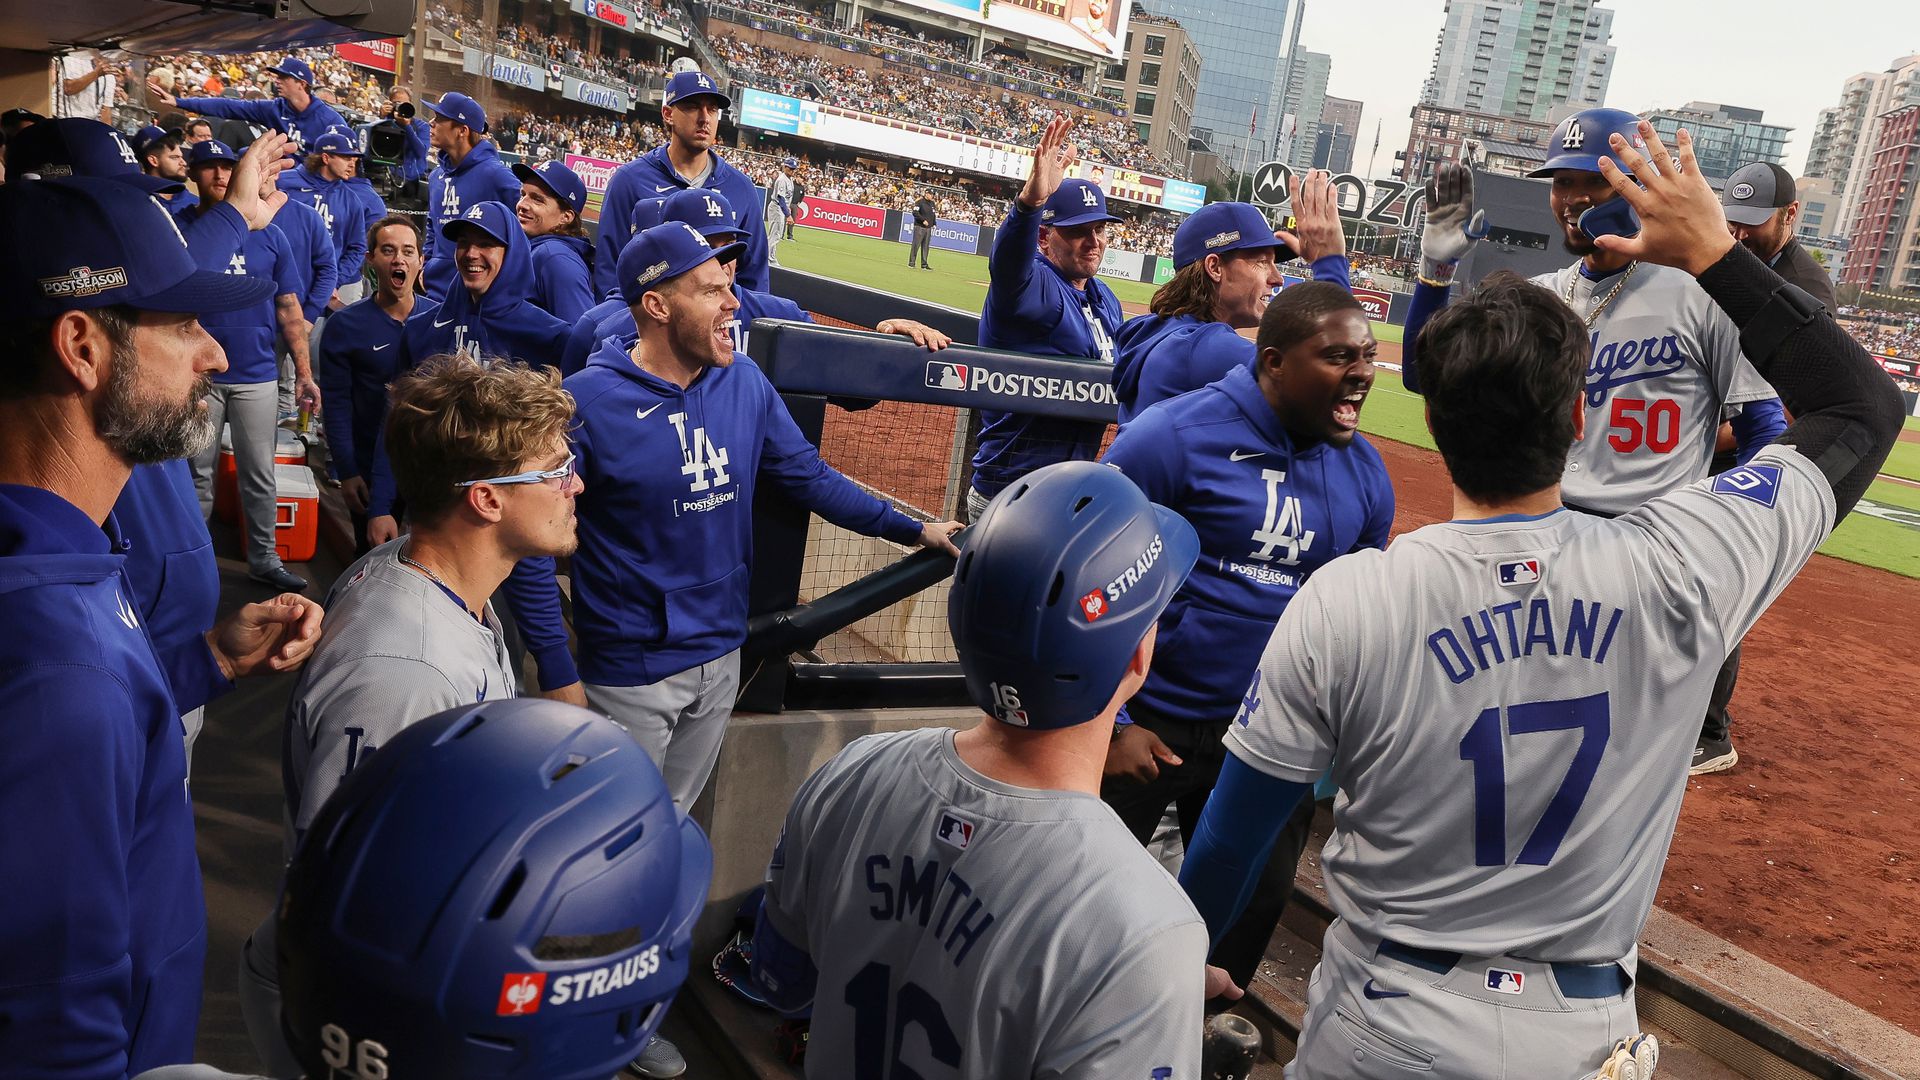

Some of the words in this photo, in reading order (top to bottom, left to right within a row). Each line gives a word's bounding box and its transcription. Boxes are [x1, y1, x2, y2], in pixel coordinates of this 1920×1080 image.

[596, 3, 627, 27] Calimax
[380, 41, 395, 54] FED
[577, 81, 618, 109] Canel's
[695, 73, 711, 89] LA
[109, 131, 138, 164] LA
[1562, 118, 1585, 150] LA
[441, 178, 460, 215] LA
[703, 196, 724, 217] LA
[1079, 185, 1099, 207] LA
[467, 204, 484, 220] LA
[813, 207, 878, 228] Snapdragon
[683, 224, 710, 247] LA
[43, 270, 125, 293] POSTSEASON
[74, 286, 99, 296] 2024
[970, 366, 1119, 405] POSTSEASON
[1608, 397, 1681, 454] 50
[667, 411, 730, 492] LA
[683, 491, 734, 511] POSTSEASON
[1248, 468, 1316, 566] LA
[1106, 534, 1164, 602] STRAUSS
[1230, 562, 1293, 586] POSTSEASON
[1428, 598, 1624, 684] OHTANI
[990, 680, 1021, 709] 16
[1459, 691, 1611, 867] 17
[865, 854, 995, 969] SMTH
[549, 944, 660, 1006] STRAUSS
[320, 1023, 389, 1080] 96
